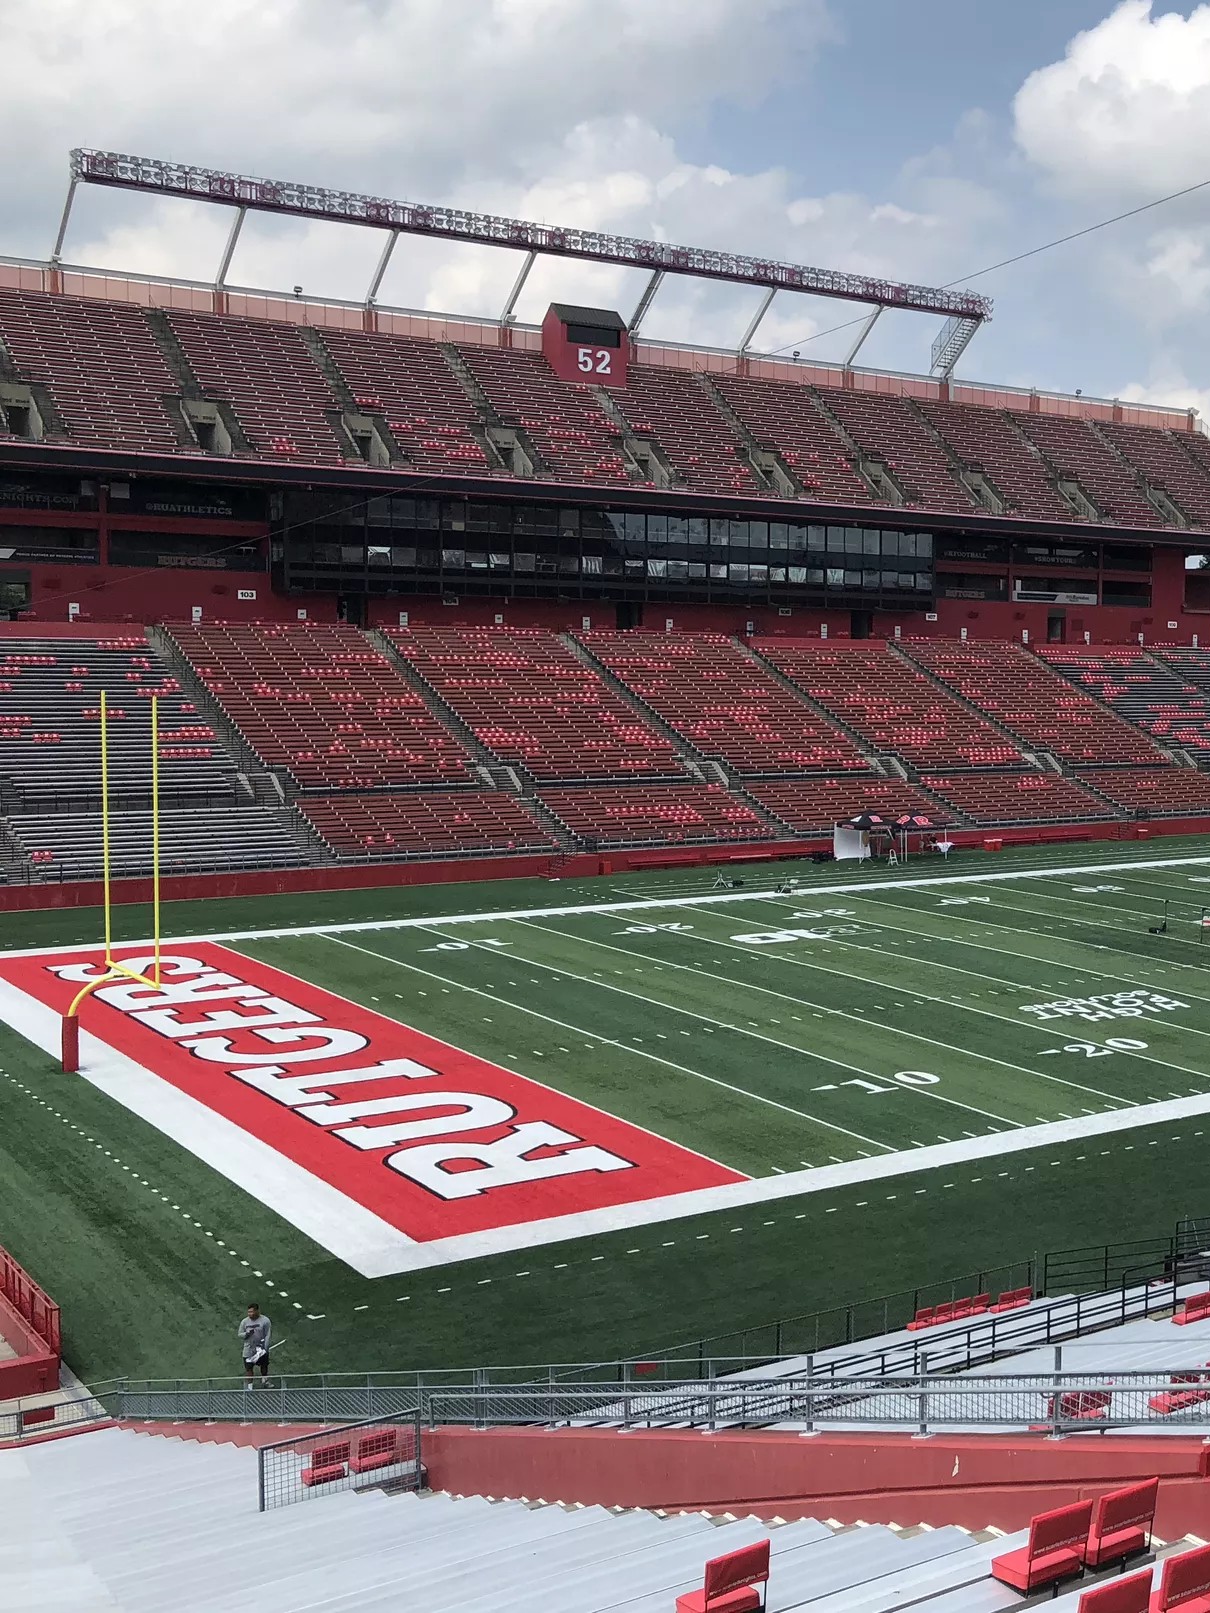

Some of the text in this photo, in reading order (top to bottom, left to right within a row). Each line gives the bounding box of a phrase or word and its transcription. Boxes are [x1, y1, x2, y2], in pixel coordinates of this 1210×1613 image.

[577, 347, 611, 375] 52
[792, 908, 857, 919] 30
[625, 922, 695, 934] 20
[435, 938, 514, 950] 10
[1017, 989, 1151, 1013] SOLUTIONS
[1032, 993, 1174, 1020] POINT
[1077, 998, 1192, 1022] HIGH
[1063, 1037, 1149, 1058] 20
[46, 954, 639, 1202] RUTGERS
[839, 1070, 941, 1095] 10
